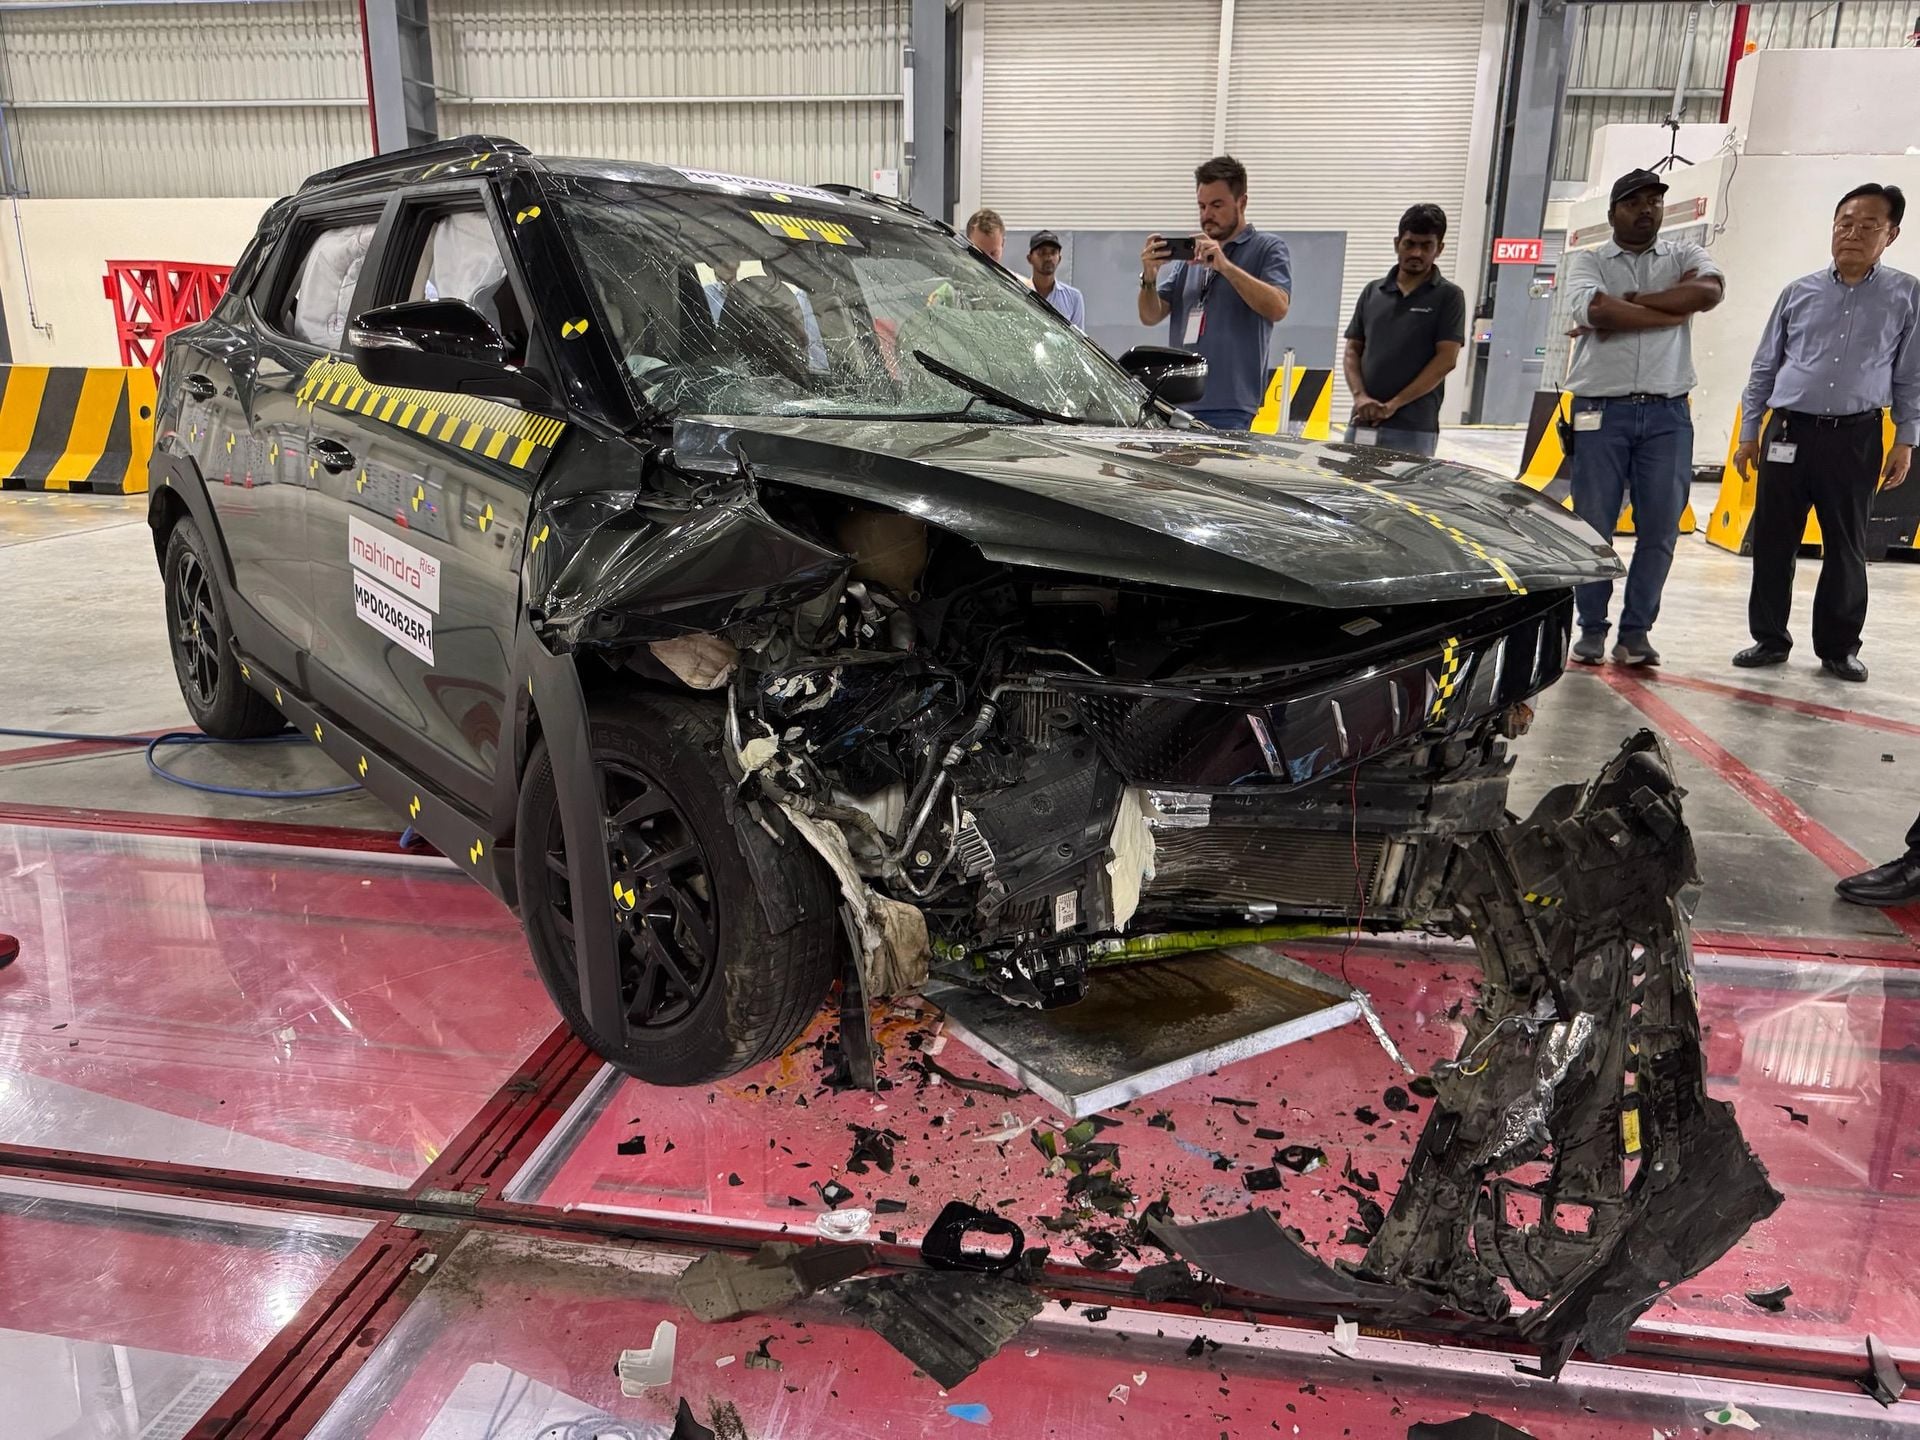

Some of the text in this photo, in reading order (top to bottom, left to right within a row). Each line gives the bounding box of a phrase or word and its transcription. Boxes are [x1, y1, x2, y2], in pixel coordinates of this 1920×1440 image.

[1497, 243, 1538, 259] EXIT 1
[353, 536, 421, 590] mahindra
[419, 557, 436, 577] Rise
[354, 583, 432, 650] MPD020625R1
